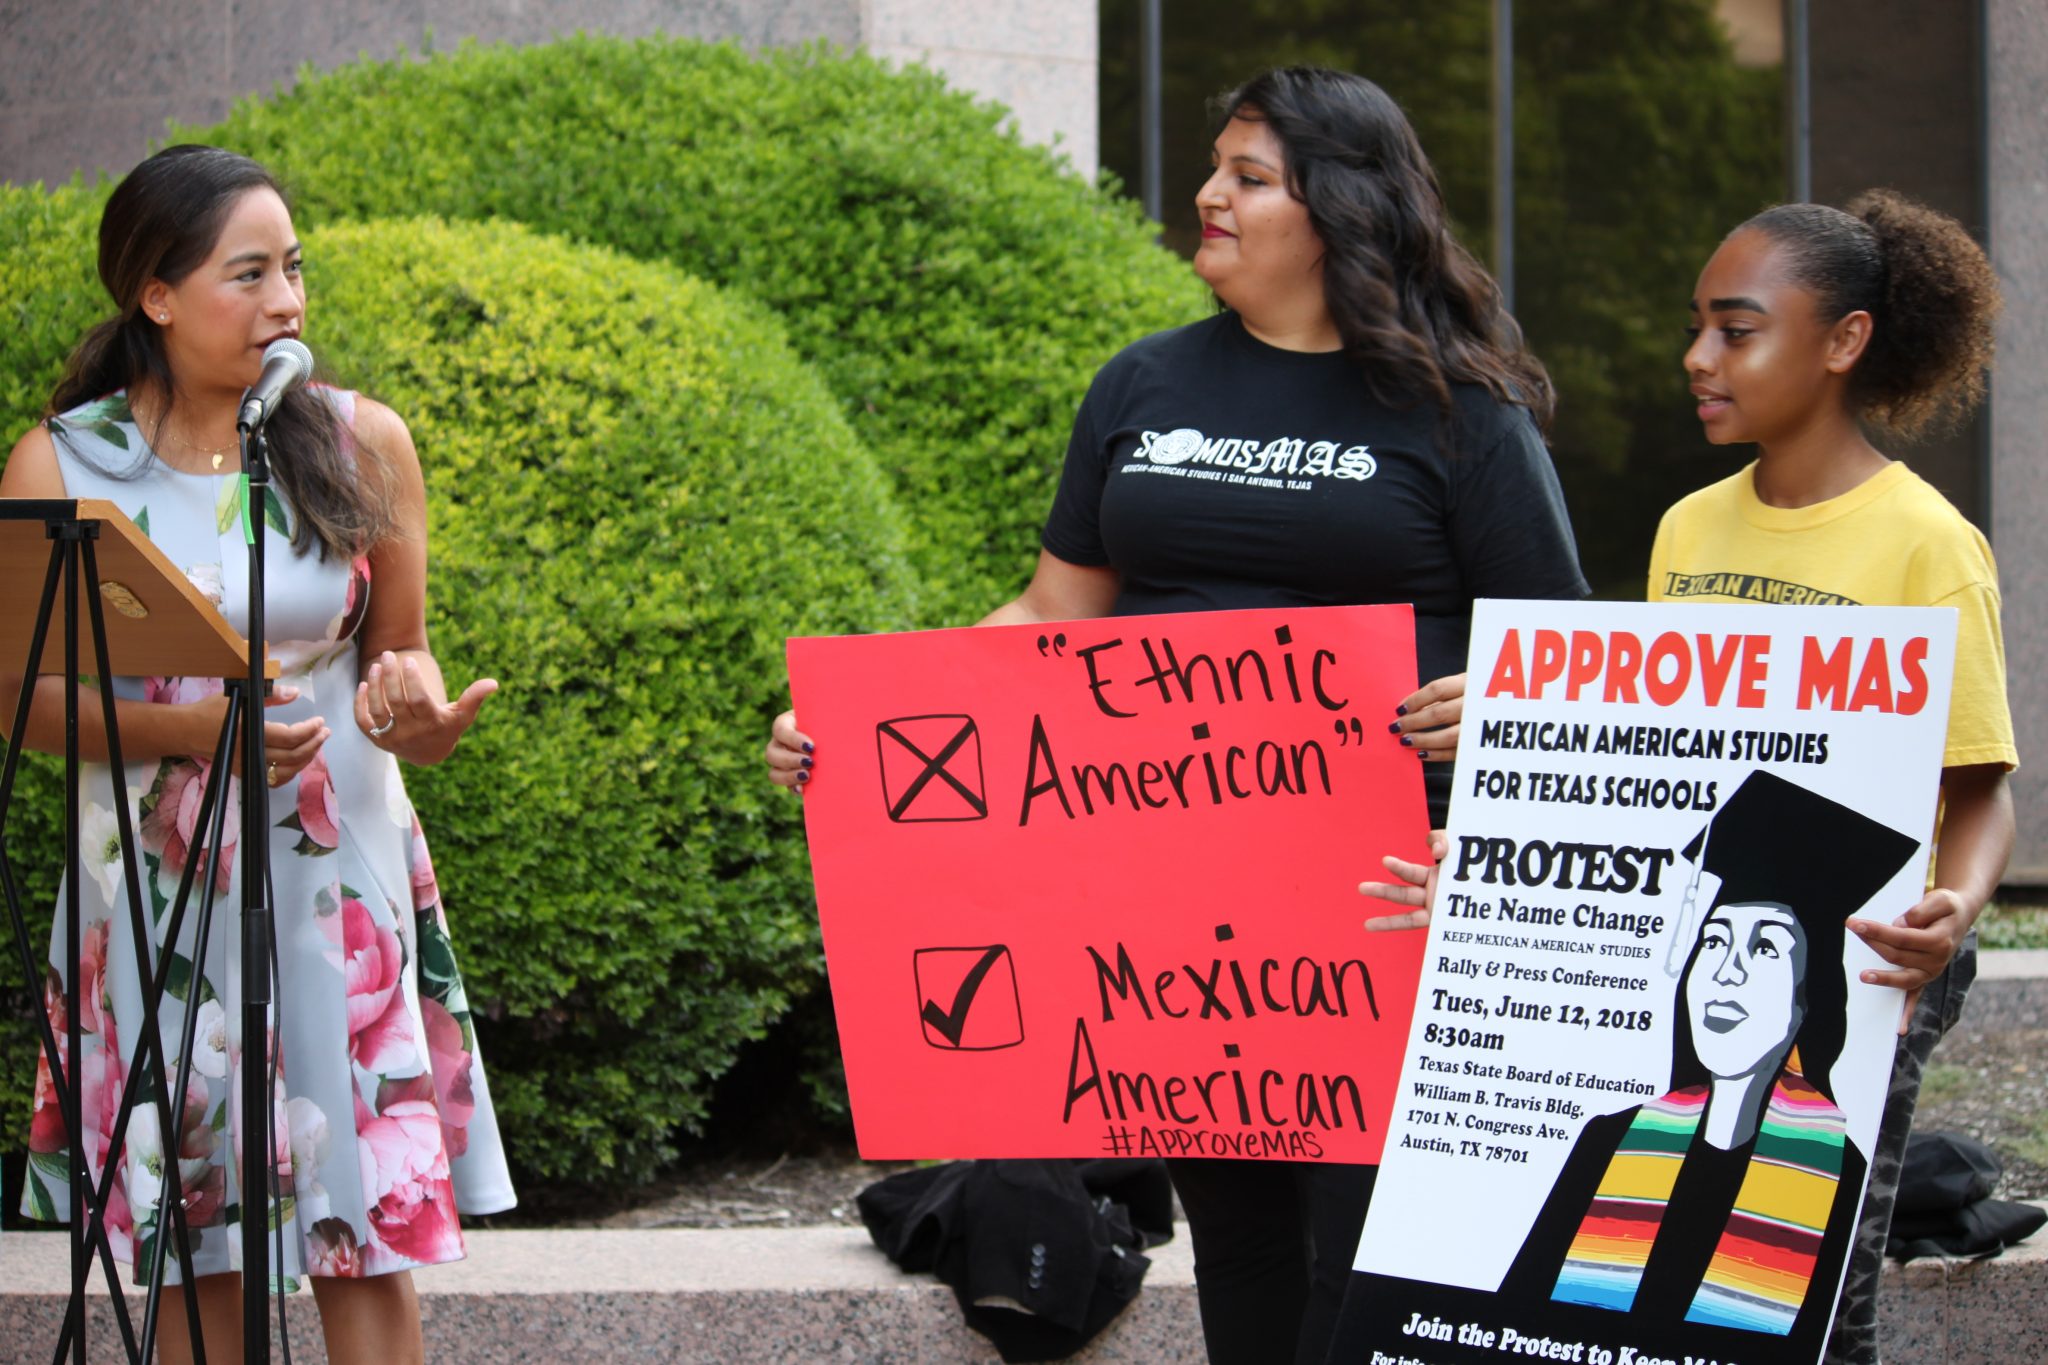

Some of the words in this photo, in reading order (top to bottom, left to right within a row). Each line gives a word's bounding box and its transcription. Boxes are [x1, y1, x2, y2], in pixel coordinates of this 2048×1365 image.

[1187, 469, 1222, 481] STUDIES
[1228, 473, 1246, 484] SAN
[1286, 480, 1312, 491] TEJAS
[1745, 577, 1862, 606] AMERIC
[1486, 628, 1772, 708] APPROVE
[1796, 635, 1929, 716] MAS
[1480, 719, 1589, 753] MEXICAN
[1592, 724, 1726, 760] AMERICAN
[1729, 729, 1829, 765] STUDIES
[1473, 769, 1522, 800] FOR
[1528, 772, 1598, 805] TEXAS
[1602, 775, 1718, 812] SCHOOLS
[1453, 835, 1674, 896] PROTEST
[1448, 893, 1492, 920] The
[1497, 897, 1566, 926] Name
[1572, 903, 1664, 938] Change
[1443, 930, 1473, 944] KEEP
[1475, 933, 1529, 949] MEXICAN
[1531, 939, 1595, 954] AMERICAN
[1599, 944, 1651, 959] STUDIES
[1086, 923, 1380, 1023] Mexican
[1437, 956, 1481, 979] Rally
[1485, 960, 1500, 977] &
[1503, 962, 1548, 982] Press
[1551, 966, 1648, 991] Conference
[1432, 988, 1489, 1019] Tues,
[1495, 995, 1552, 1022] June
[1557, 1004, 1590, 1030] 12,
[1596, 1008, 1653, 1032] 2018
[1424, 1022, 1505, 1051] 8:30am
[1063, 1017, 1367, 1133] American
[1419, 1055, 1460, 1074] Texas
[1462, 1060, 1503, 1079] State
[1505, 1065, 1553, 1085] Board
[1555, 1071, 1573, 1087] of
[1574, 1072, 1656, 1096] Education
[1413, 1082, 1471, 1104] William
[1474, 1089, 1489, 1106] B.
[1494, 1091, 1542, 1112] Travis
[1544, 1097, 1585, 1119] Bldg.
[1406, 1109, 1440, 1125] 1701
[1444, 1111, 1461, 1128] N.
[1464, 1114, 1533, 1137] Congress
[1535, 1122, 1569, 1141] Ave.
[1399, 1133, 1455, 1155] Austin,
[1460, 1140, 1482, 1157] TX
[1485, 1145, 1529, 1163] 78701
[1402, 1312, 1453, 1342] Join
[1457, 1323, 1496, 1348] the
[1498, 1327, 1585, 1362] Protest
[1587, 1344, 1613, 1365] to
